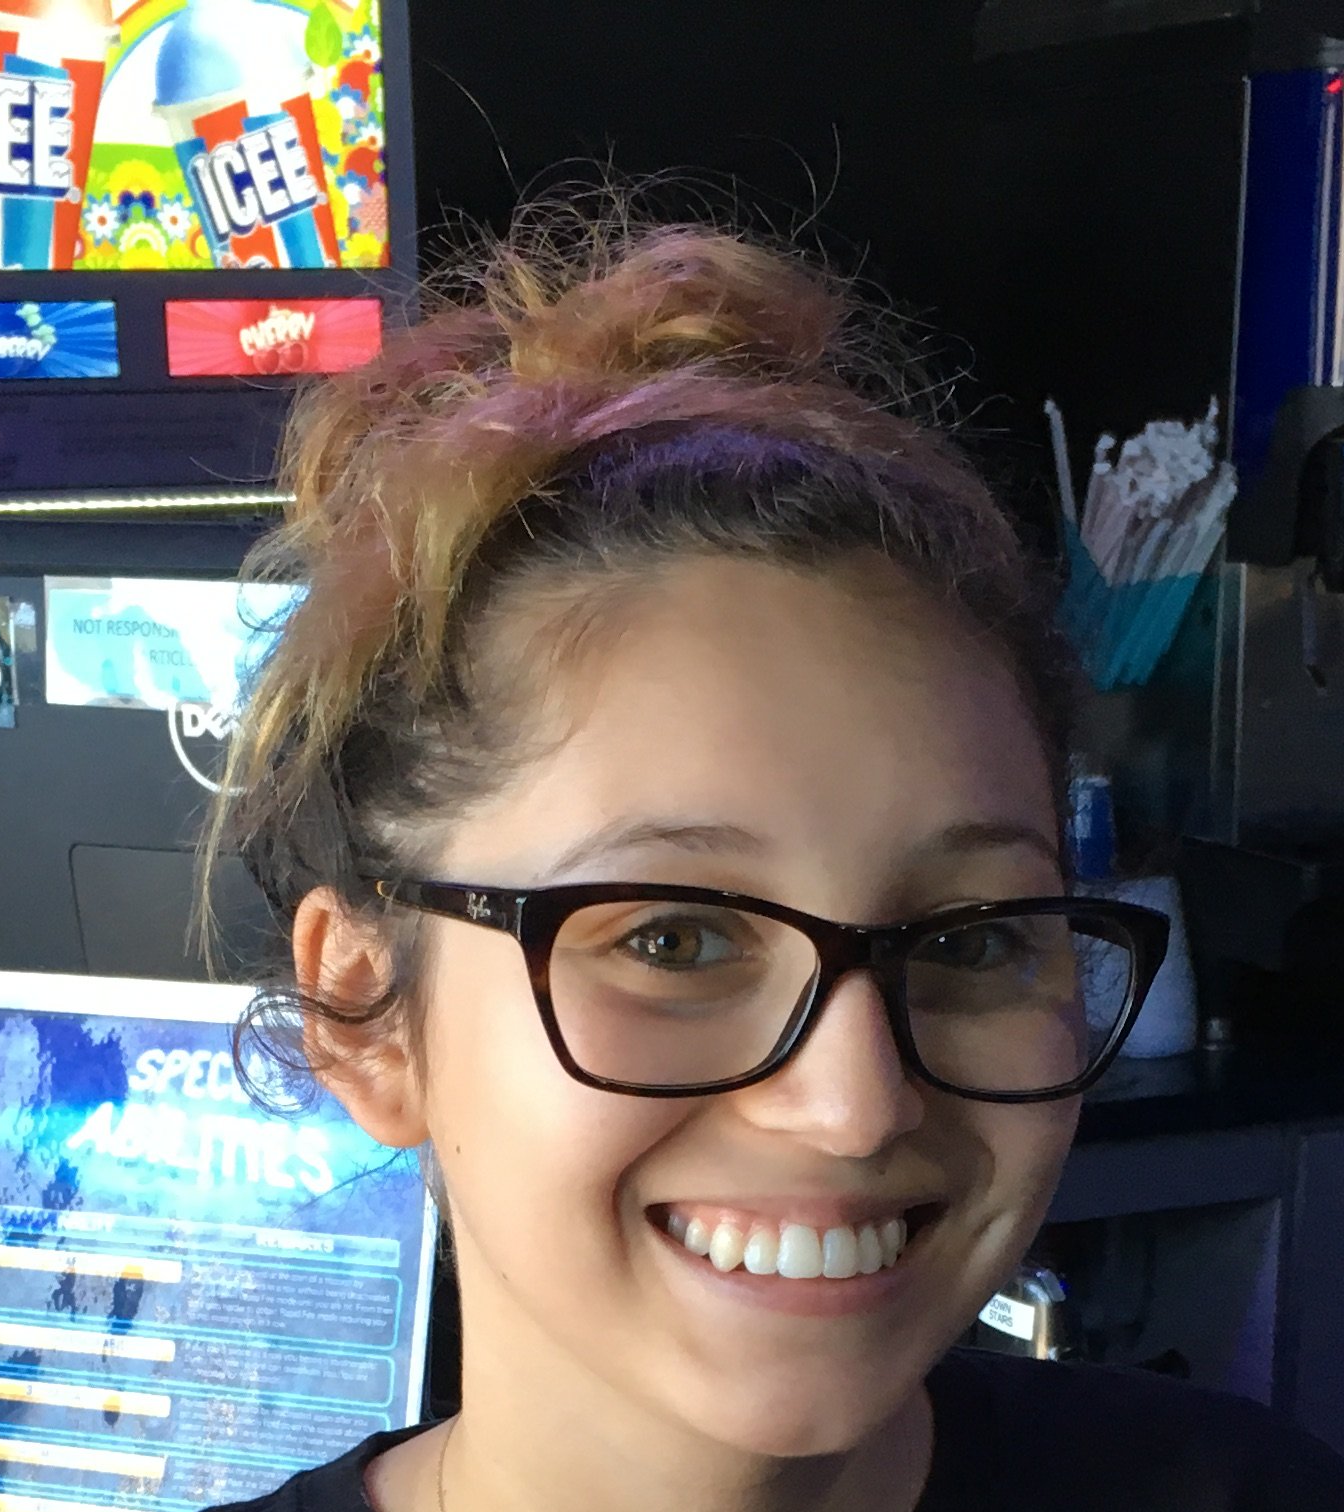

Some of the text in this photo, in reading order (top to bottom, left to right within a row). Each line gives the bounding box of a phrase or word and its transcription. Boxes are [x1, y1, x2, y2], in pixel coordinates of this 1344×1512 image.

[190, 118, 318, 243] ICEE
[72, 619, 102, 635] NOT
[65, 1101, 334, 1195] ABILITIES
